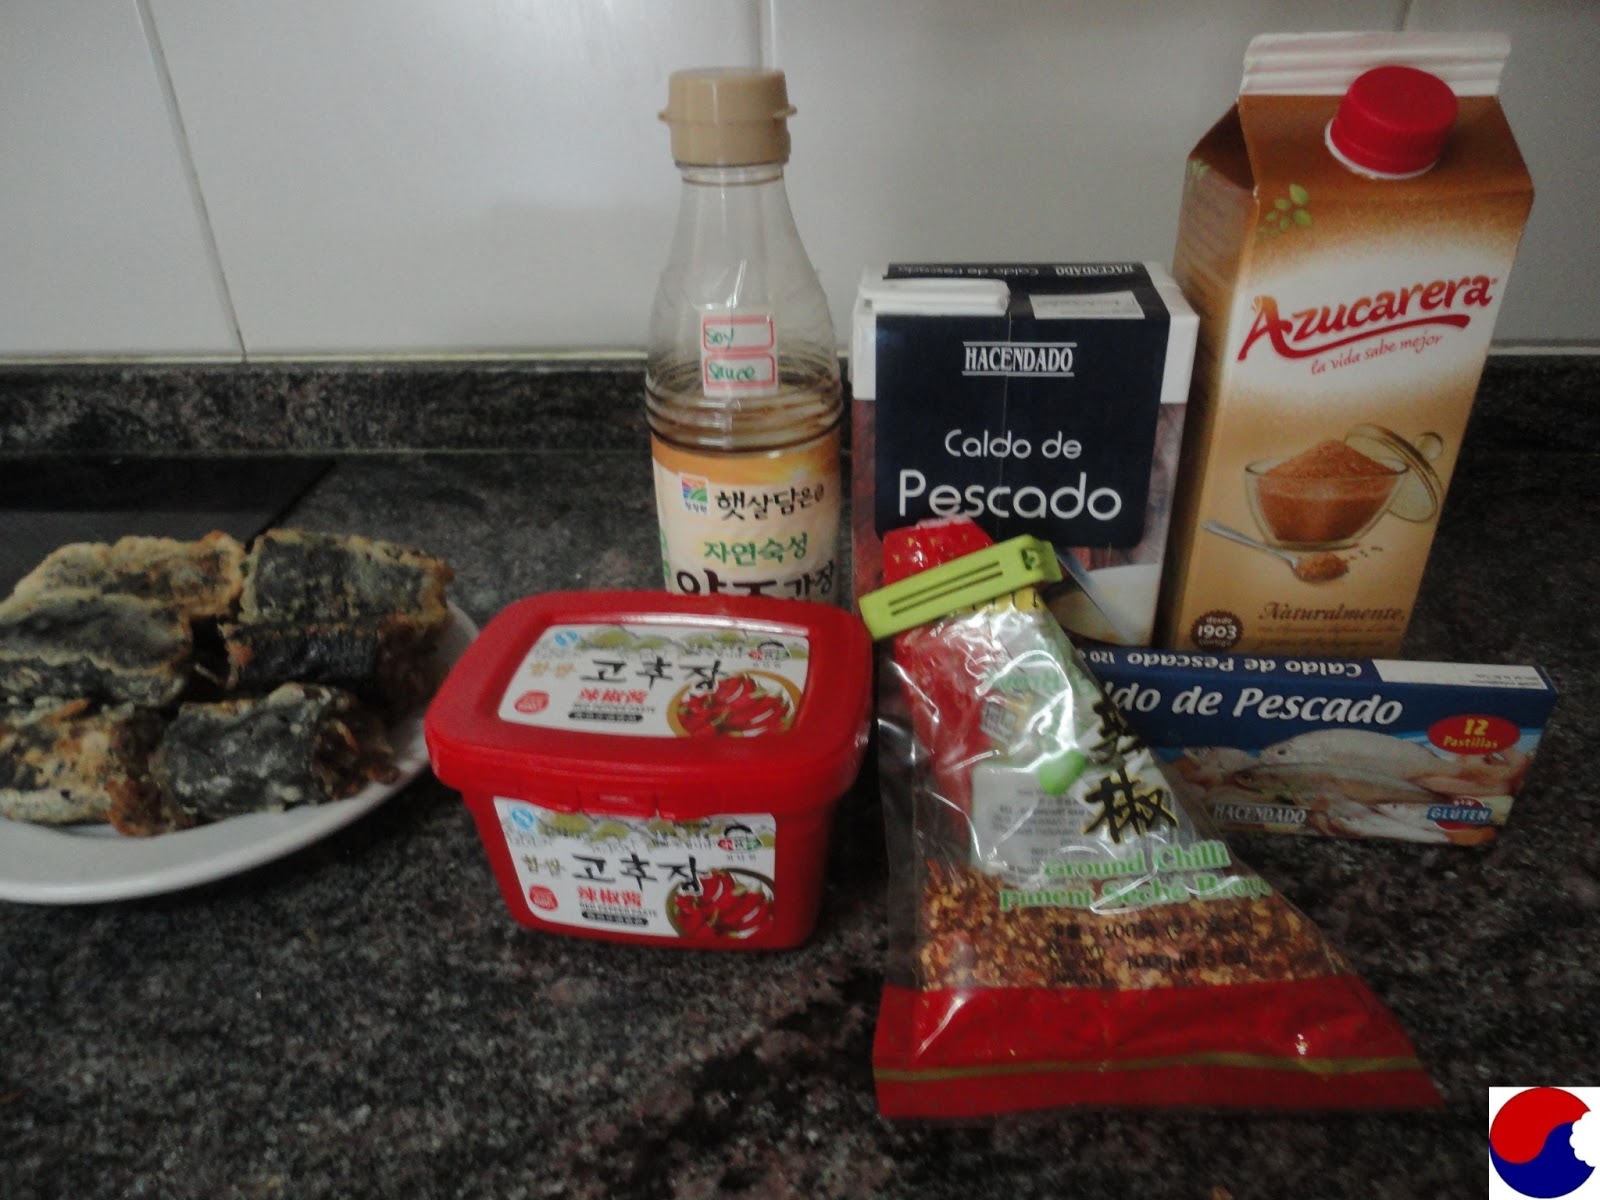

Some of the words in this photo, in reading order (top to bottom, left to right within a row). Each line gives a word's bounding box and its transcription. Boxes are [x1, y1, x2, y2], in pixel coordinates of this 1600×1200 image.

[1237, 275, 1493, 362] Azucarera
[964, 346, 1073, 372] HACENDADO
[1331, 350, 1361, 370] vida
[1364, 338, 1395, 360] sabe
[1400, 329, 1443, 354] mejor
[945, 429, 1032, 459] Caldo
[1041, 430, 1082, 459] de
[899, 469, 1122, 521] Pescado
[1197, 625, 1237, 640] 1903
[1127, 652, 1235, 672] Pescado
[1243, 657, 1276, 673] de
[1285, 658, 1362, 678] Caldo
[1171, 685, 1223, 716] de
[1232, 687, 1403, 726] Pescado
[1463, 718, 1490, 736] 12
[1442, 735, 1498, 749] Pastillas
[1155, 839, 1232, 872] Chilli
